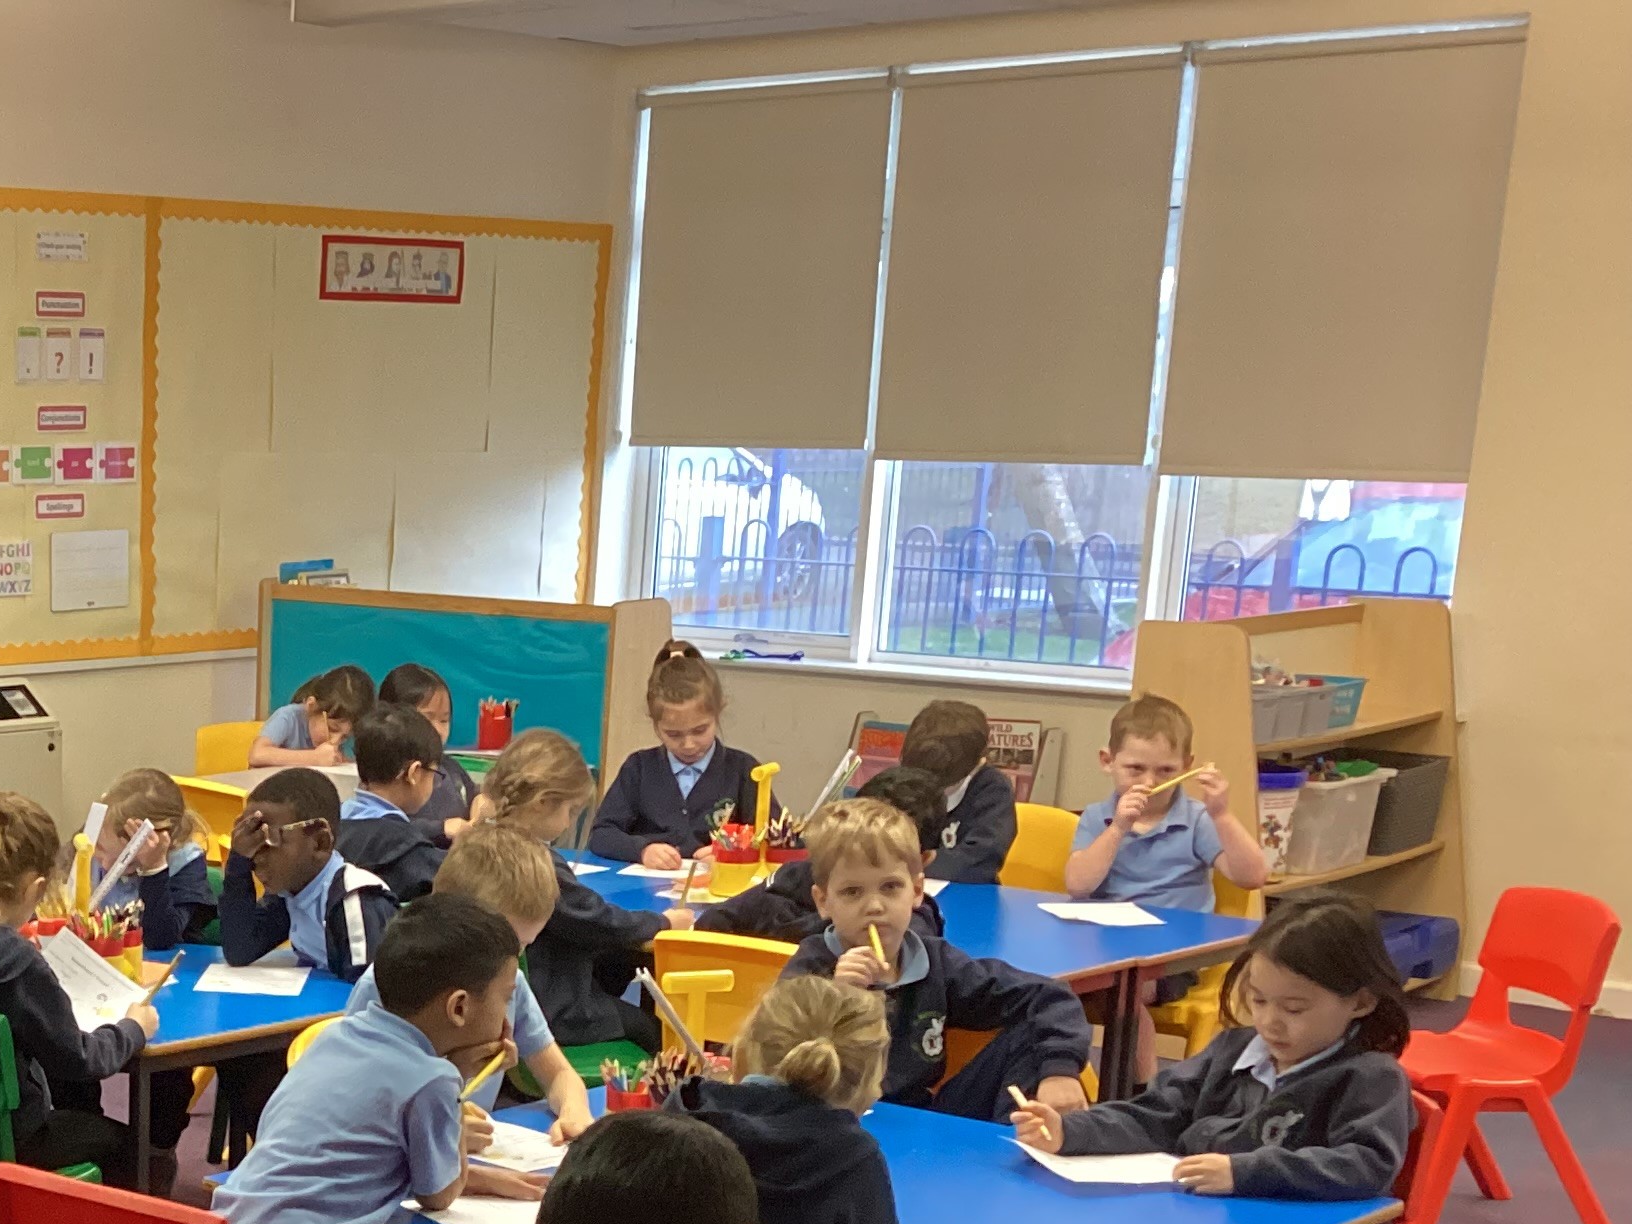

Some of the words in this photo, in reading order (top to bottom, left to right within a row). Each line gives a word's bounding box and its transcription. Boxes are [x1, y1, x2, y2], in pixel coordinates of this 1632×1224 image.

[54, 352, 64, 373] ?
[88, 352, 94, 374] !
[46, 502, 74, 513] Spellings
